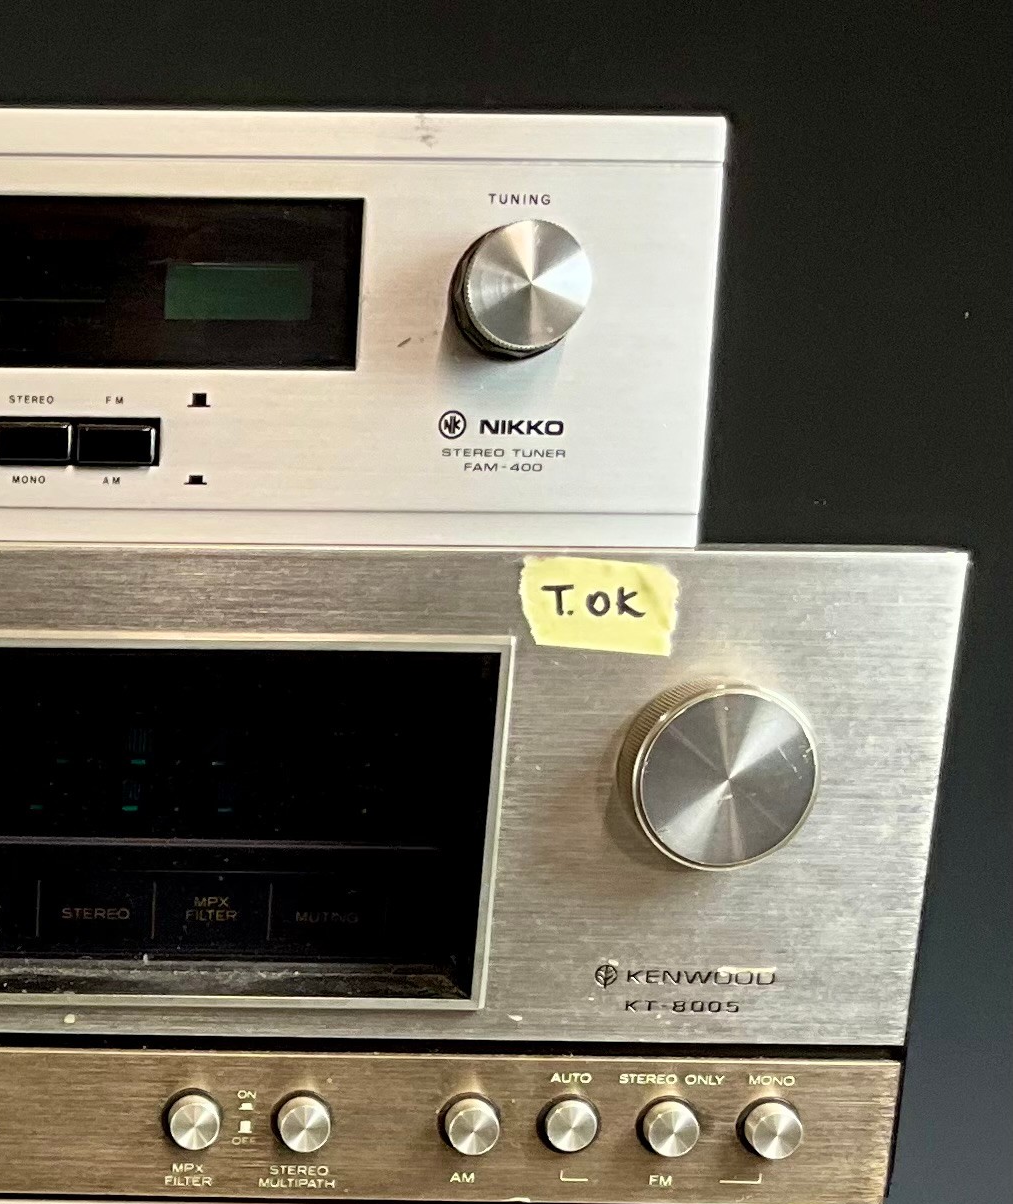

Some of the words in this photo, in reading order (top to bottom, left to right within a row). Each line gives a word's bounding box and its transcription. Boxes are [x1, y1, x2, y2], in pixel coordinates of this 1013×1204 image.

[488, 192, 551, 207] TUNING
[8, 393, 55, 405] STEREO
[479, 418, 565, 437] NIKKO
[441, 446, 505, 459] STEREO
[511, 447, 567, 459] TUNER
[462, 461, 543, 473] FAM-400
[11, 474, 47, 485] MONO
[193, 895, 230, 908] MPX
[60, 906, 131, 921] STEREO
[185, 908, 238, 923] FILTER
[295, 910, 360, 925] MUTING
[626, 968, 777, 986] KENWOOD
[624, 999, 740, 1014] KT-8005
[549, 1072, 593, 1085] AUTO
[618, 1073, 678, 1086] STEREO
[684, 1073, 726, 1087] ONLY
[748, 1074, 796, 1088] MONO
[236, 1089, 257, 1100] ON
[231, 1135, 257, 1146] OFF
[171, 1163, 204, 1175] MPX
[268, 1165, 329, 1177] STEREO
[163, 1175, 213, 1188] FILTER
[257, 1177, 337, 1190] MULTIPATH
[449, 1171, 475, 1184] AM
[648, 1174, 673, 1187] FM
